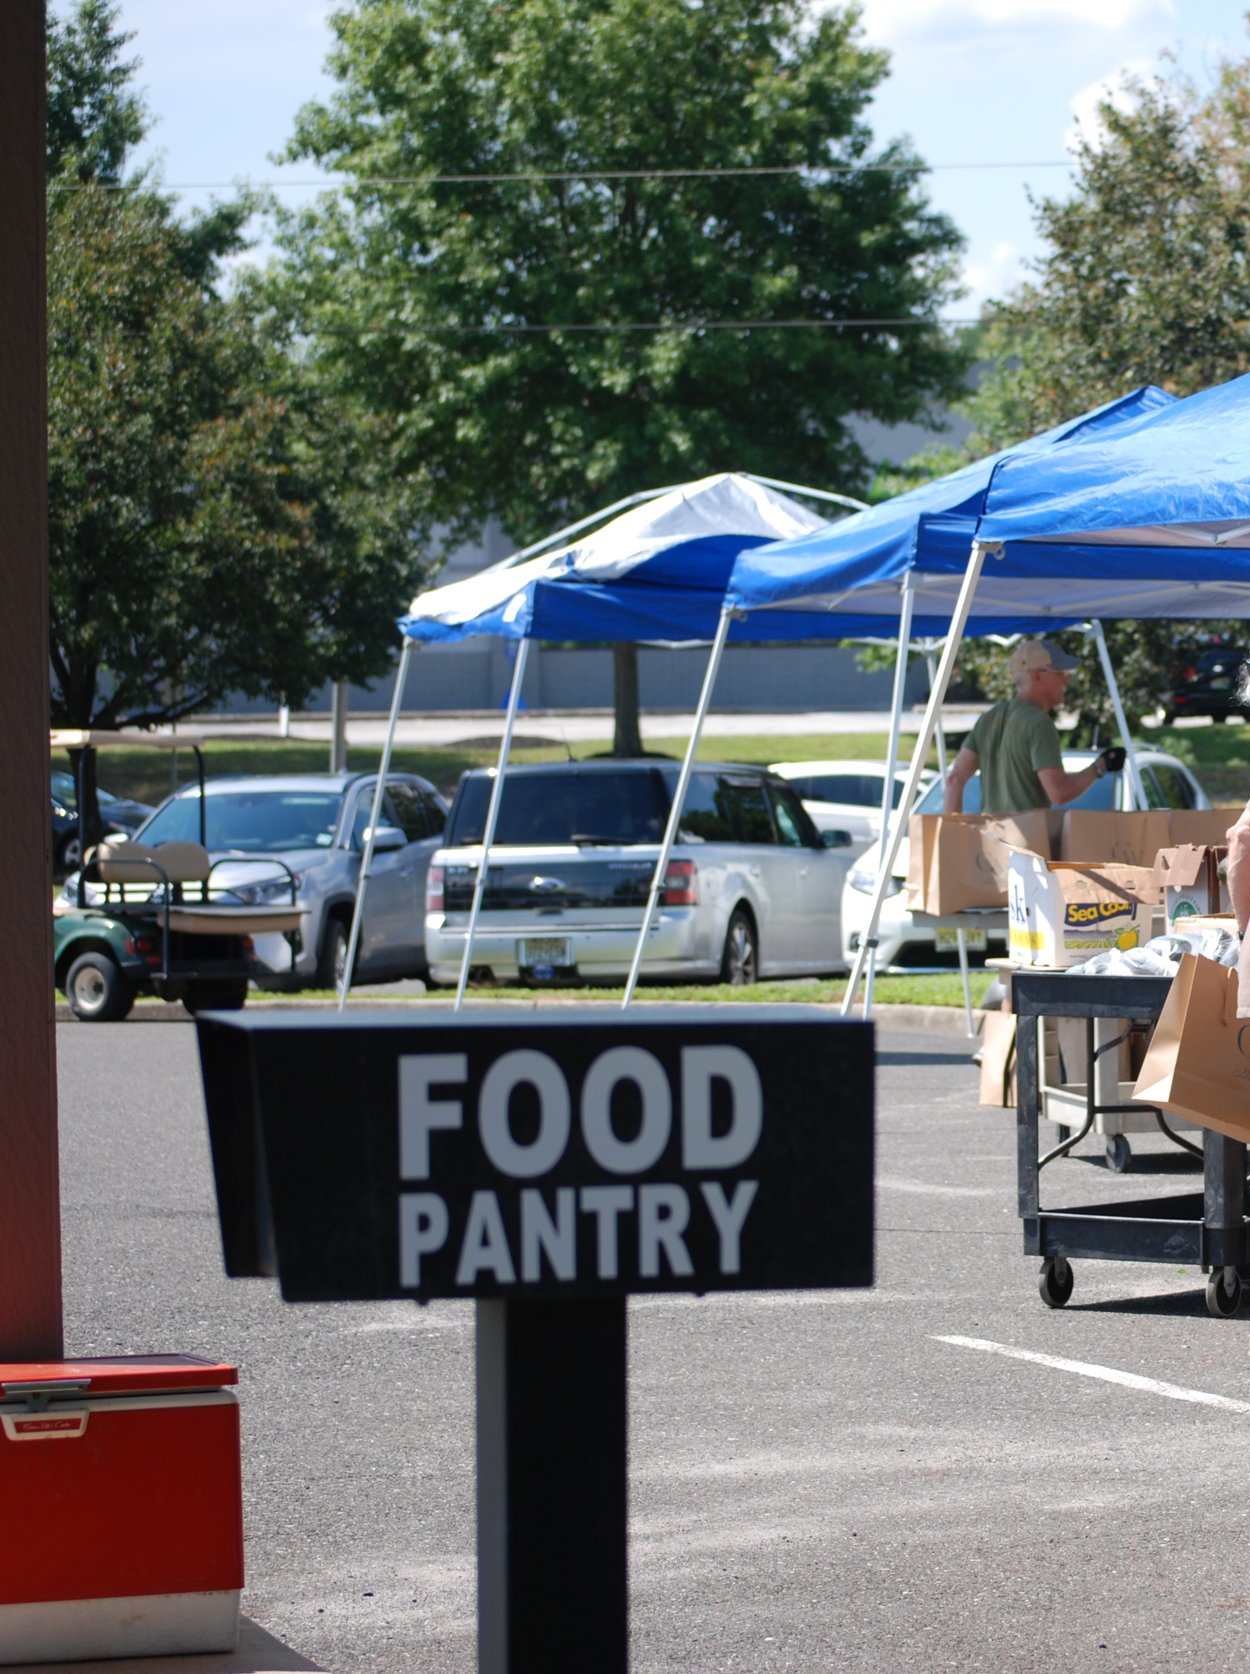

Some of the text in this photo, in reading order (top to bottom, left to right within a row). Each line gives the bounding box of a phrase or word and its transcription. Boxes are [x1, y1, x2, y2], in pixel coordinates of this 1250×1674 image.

[1068, 904, 1099, 923] Sea
[398, 1045, 764, 1181] FOOD
[399, 1180, 760, 1288] PANTRY
